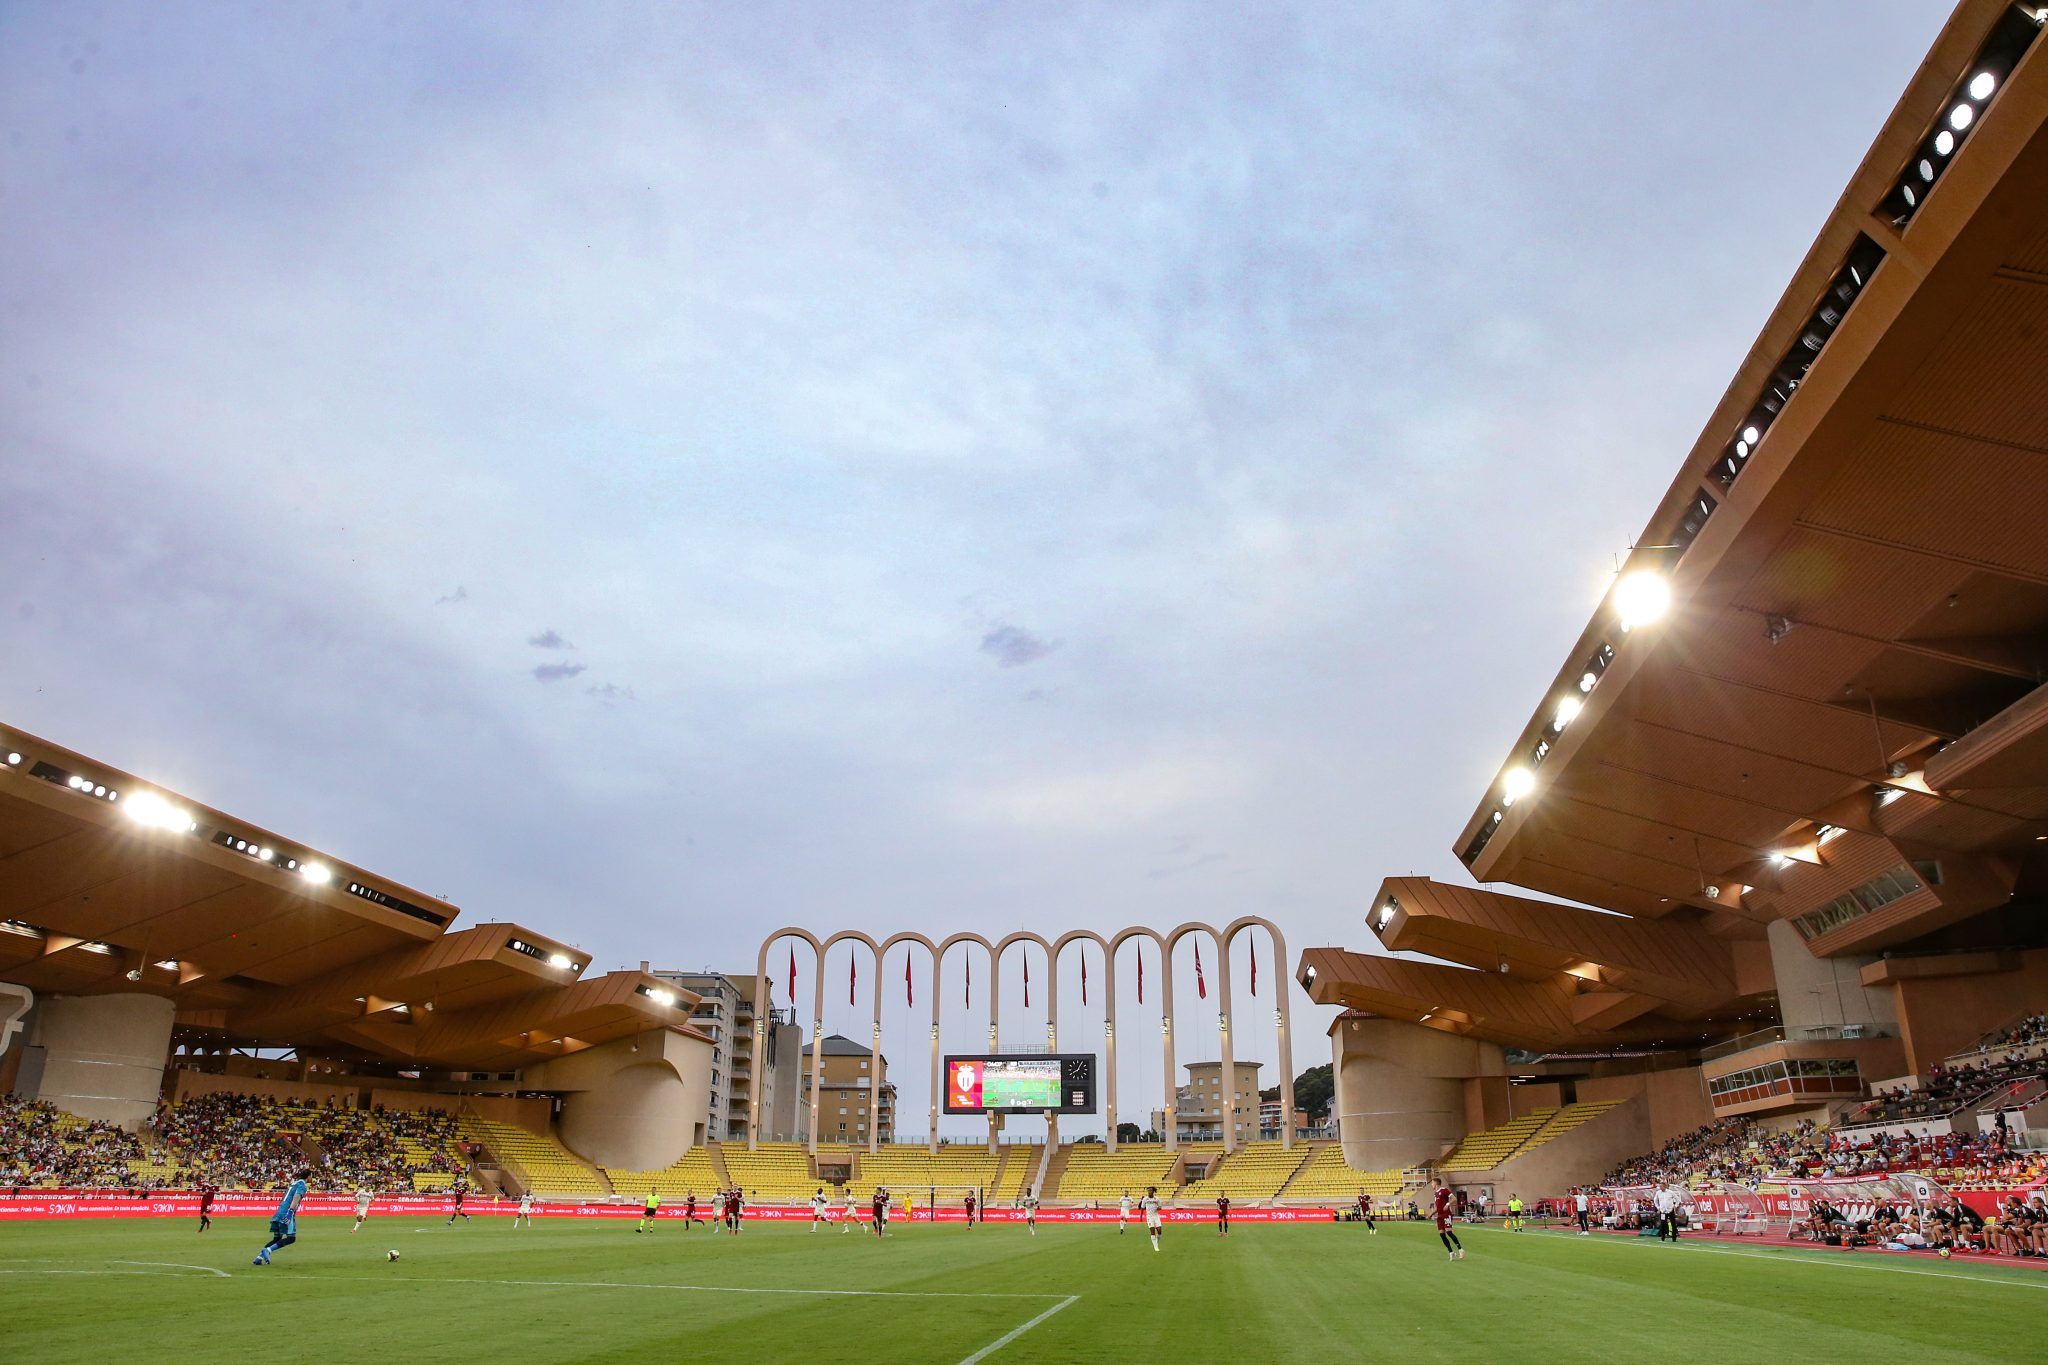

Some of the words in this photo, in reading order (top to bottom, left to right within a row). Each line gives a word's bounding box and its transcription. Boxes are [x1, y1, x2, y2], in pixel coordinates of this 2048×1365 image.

[48, 1204, 76, 1214] SOKIN
[152, 1203, 175, 1213] SOKIN
[577, 1207, 599, 1215] SOKIN
[760, 1210, 782, 1218] SOKIN
[1070, 1212, 1094, 1220] SOKIN
[1170, 1212, 1194, 1220] SOKIN
[1271, 1211, 1296, 1220] SOKIN
